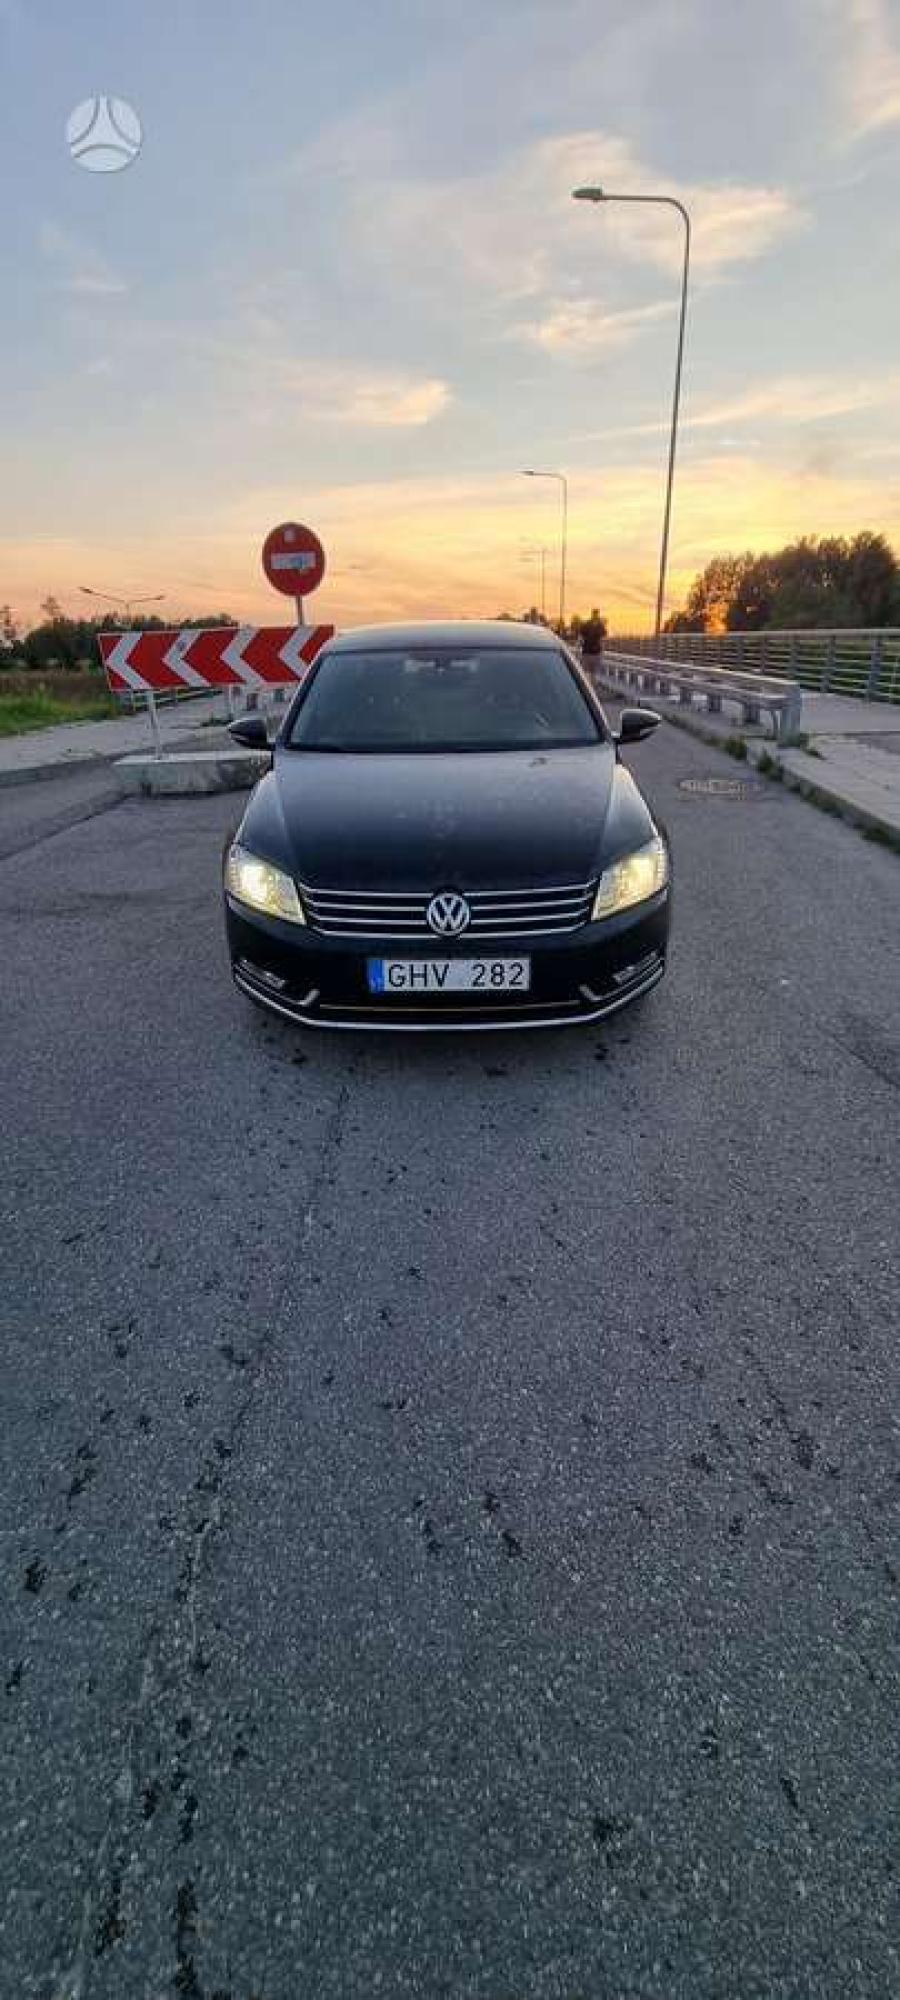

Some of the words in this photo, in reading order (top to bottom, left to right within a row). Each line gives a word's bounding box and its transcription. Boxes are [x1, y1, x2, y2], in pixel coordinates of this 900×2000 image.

[429, 895, 469, 934] VW
[388, 963, 450, 988] GHV
[471, 961, 525, 988] 282
